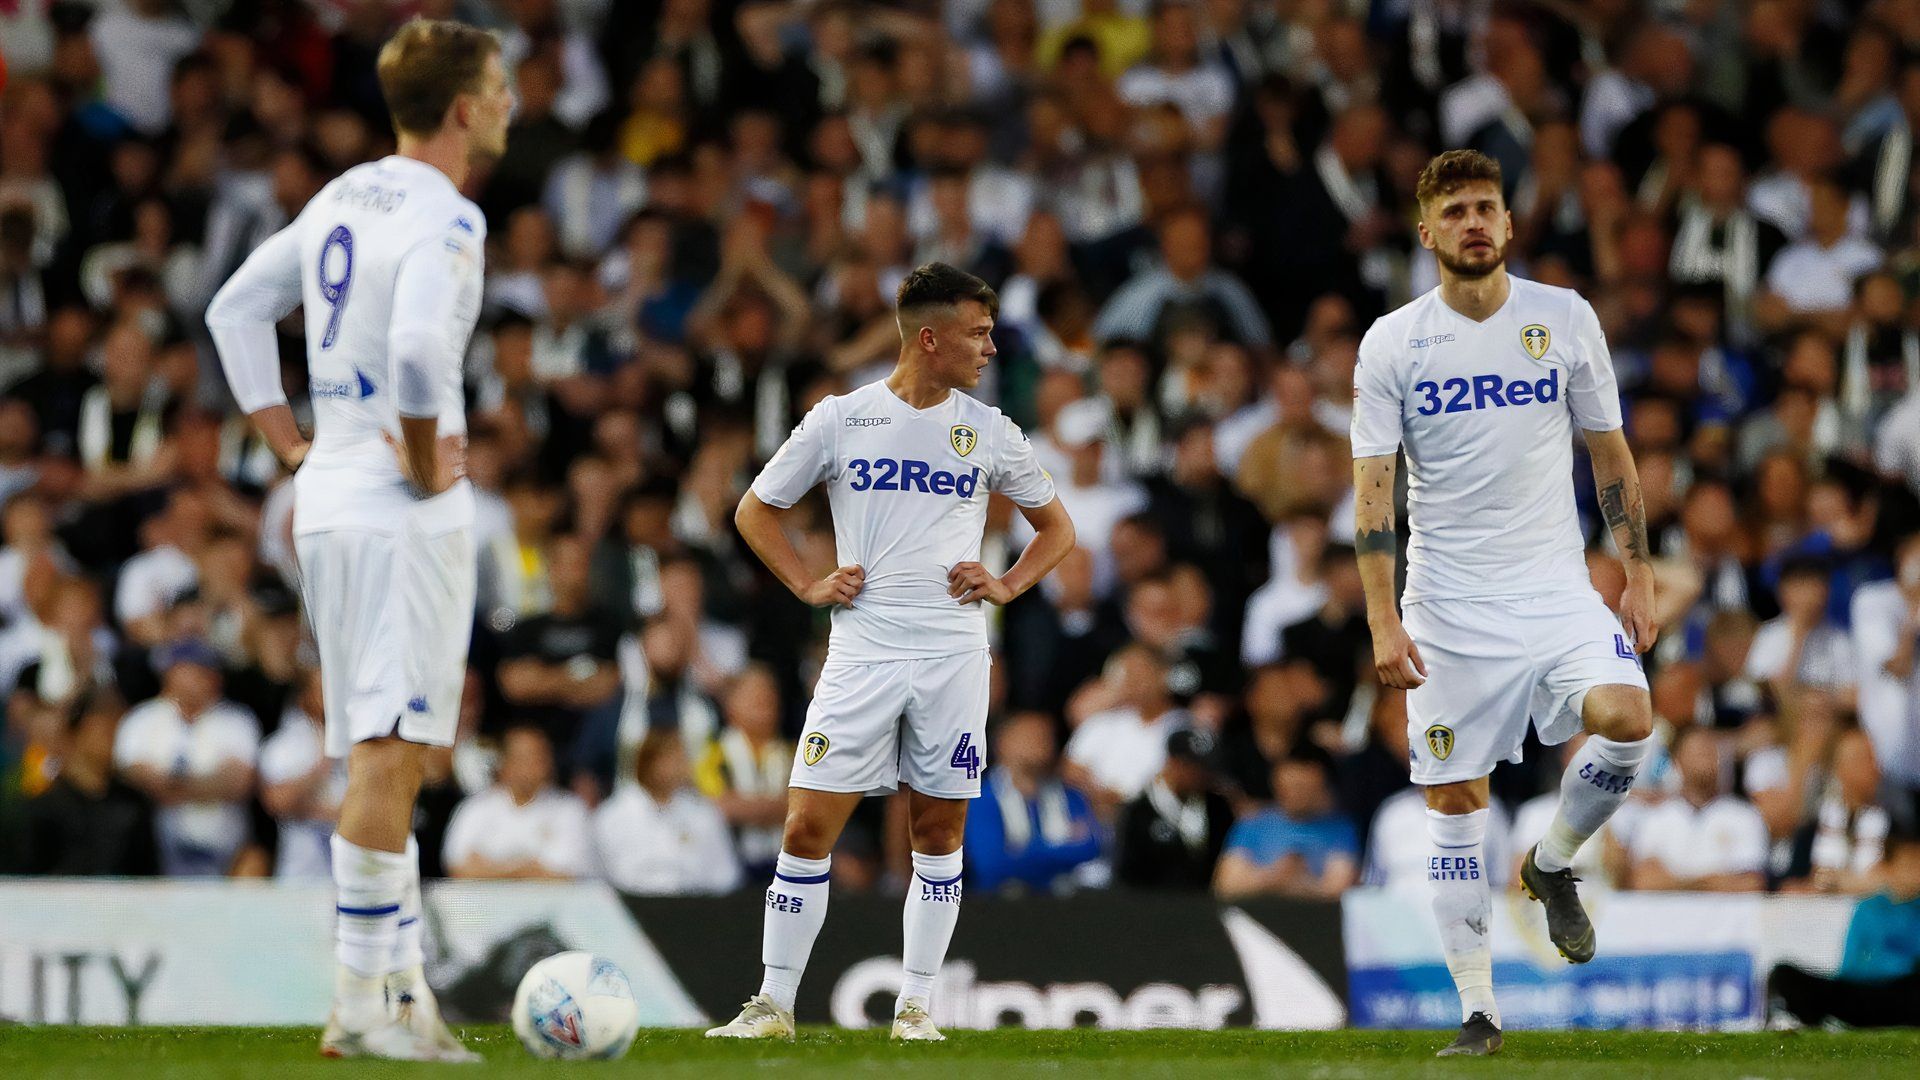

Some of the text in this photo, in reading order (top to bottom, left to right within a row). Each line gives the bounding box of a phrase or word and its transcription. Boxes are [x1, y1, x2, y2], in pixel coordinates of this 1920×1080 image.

[319, 224, 353, 350] 9
[1414, 368, 1559, 416] 32Red
[849, 458, 980, 499] 32Red
[951, 732, 980, 780] 4
[1584, 762, 1639, 787] LEED
[1427, 856, 1478, 870] EEDS
[1428, 870, 1480, 881] NITED
[767, 889, 804, 907] EDS
[922, 883, 962, 898] LEED
